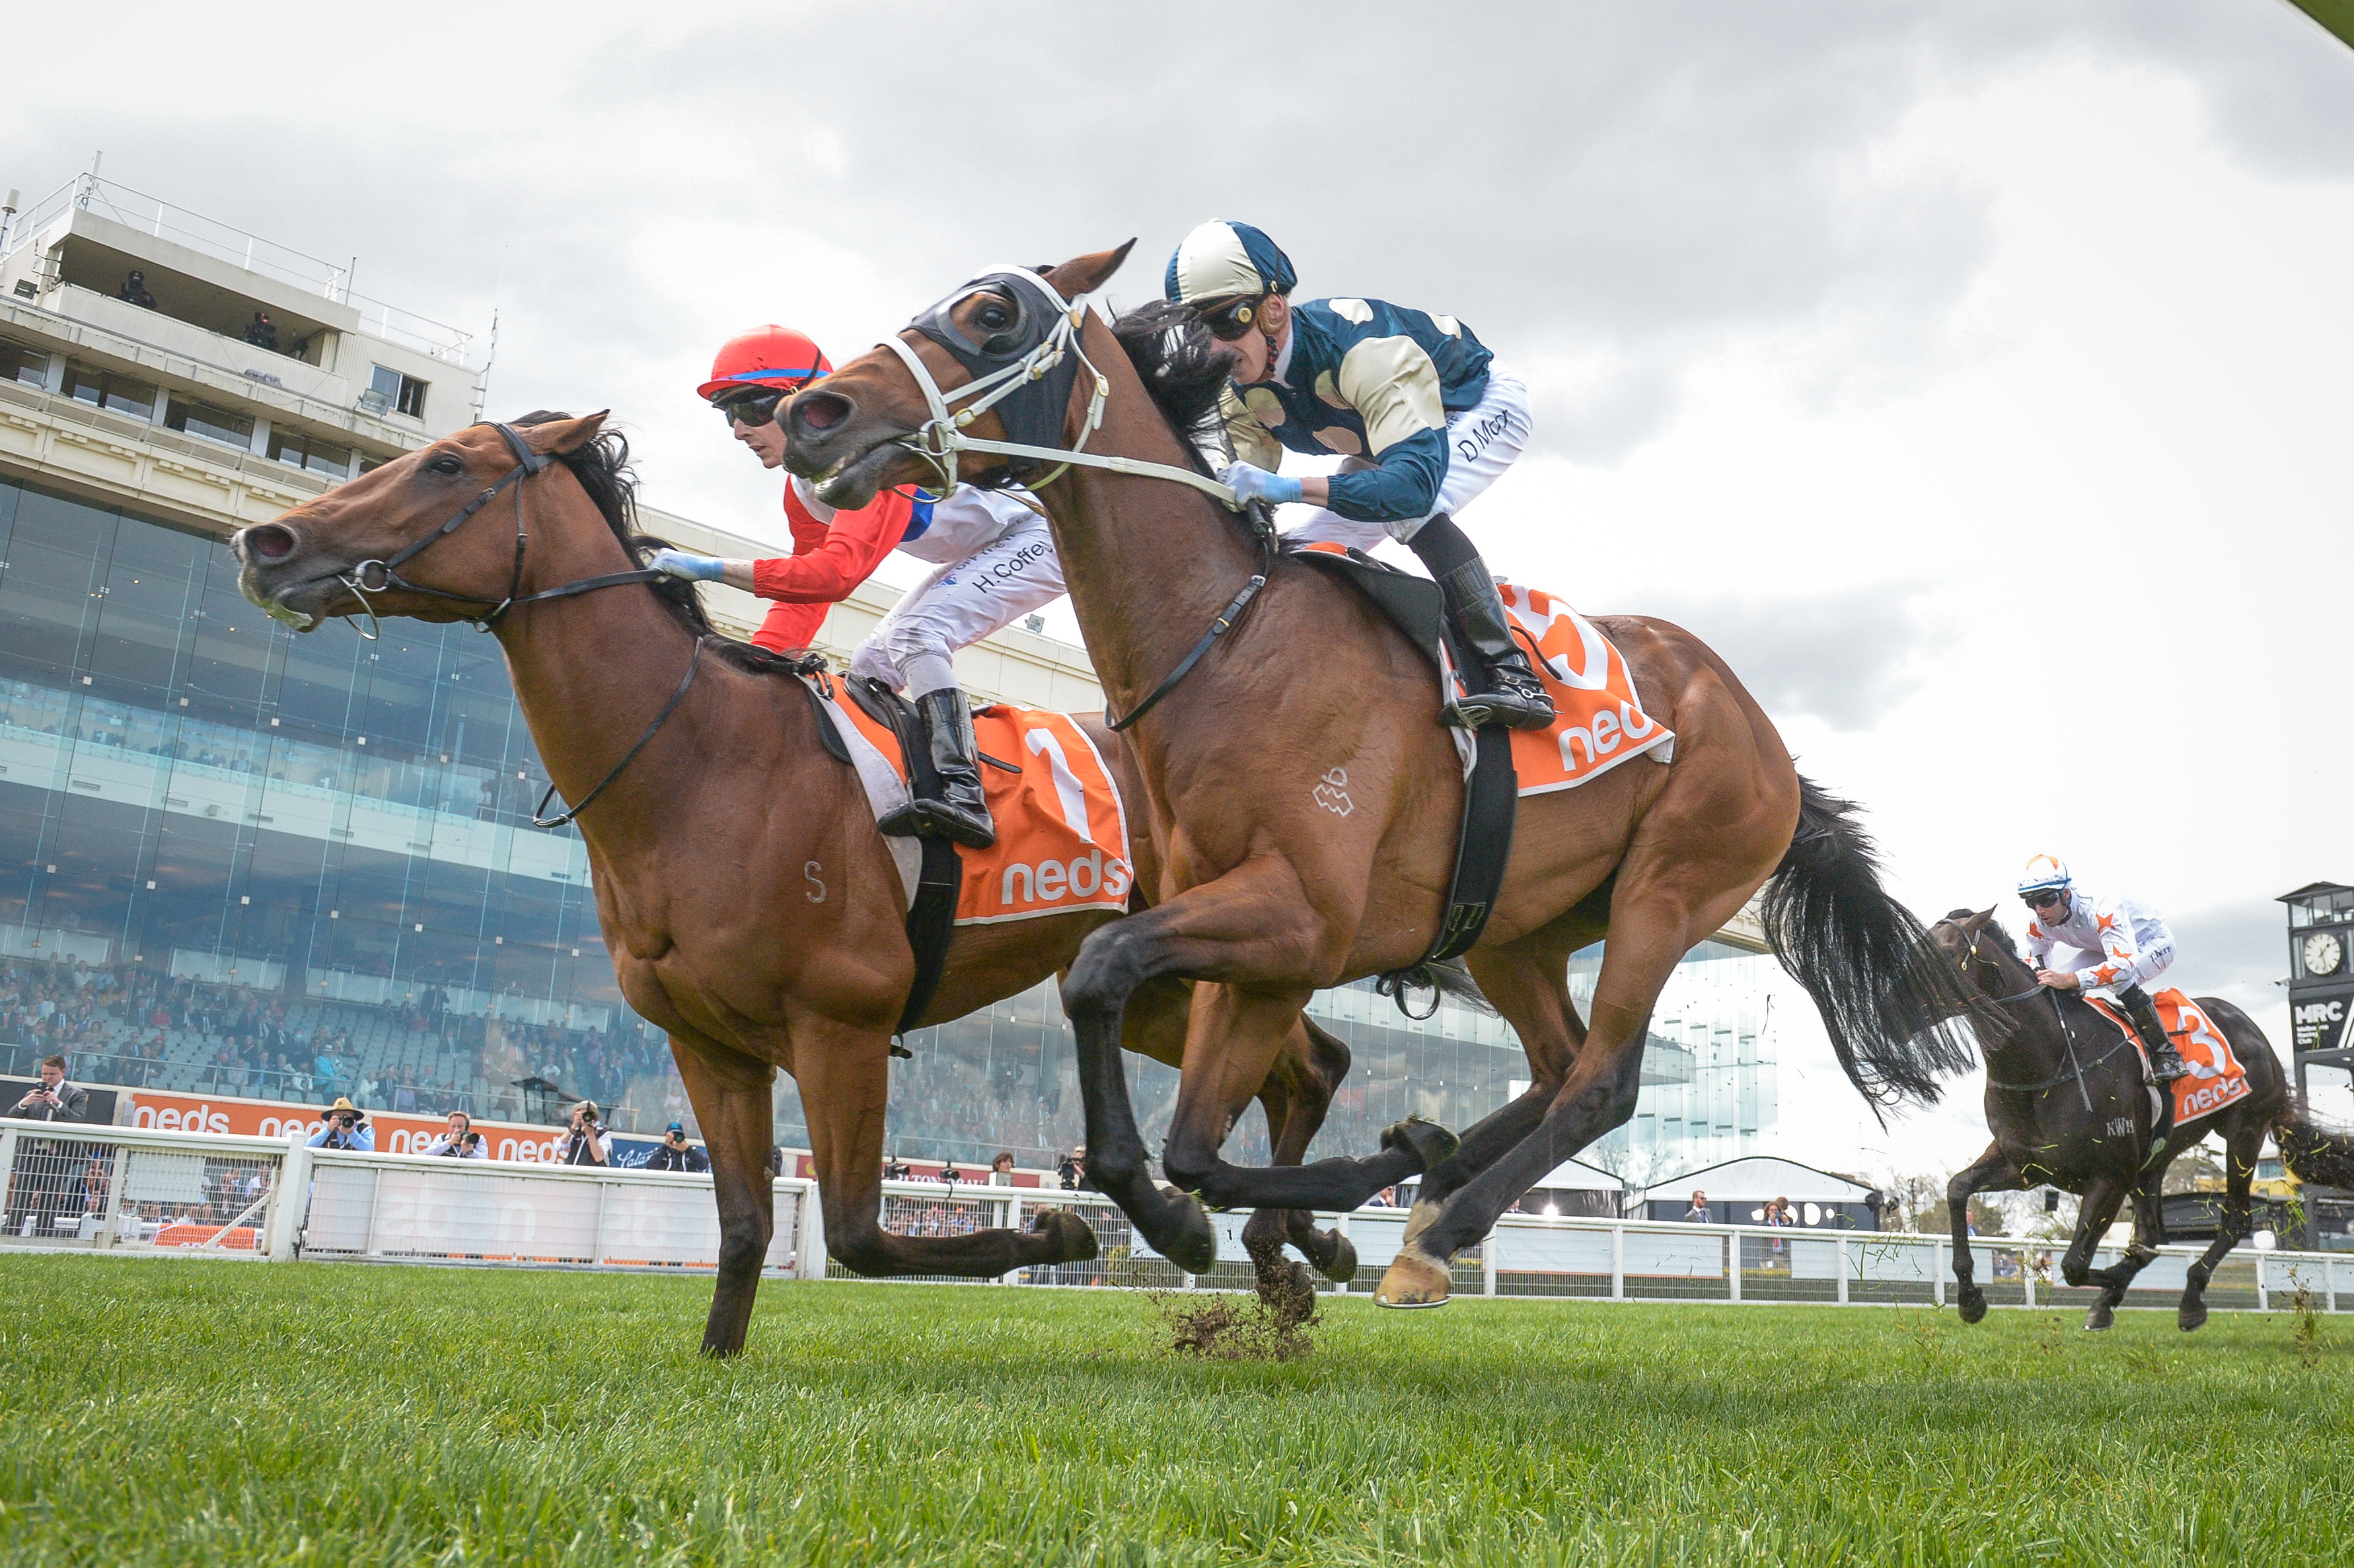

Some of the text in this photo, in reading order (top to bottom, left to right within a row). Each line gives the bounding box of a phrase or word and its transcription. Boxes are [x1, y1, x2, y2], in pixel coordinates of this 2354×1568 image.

[972, 540, 1054, 594] H.Coffey
[1558, 699, 1654, 772] ned
[1025, 728, 1095, 844] 1
[803, 861, 827, 904] S
[1002, 849, 1133, 905] neds
[2295, 1001, 2344, 1025] MRC
[2177, 1005, 2226, 1080] 3
[132, 1104, 229, 1134] neds
[2182, 1076, 2242, 1116] neds
